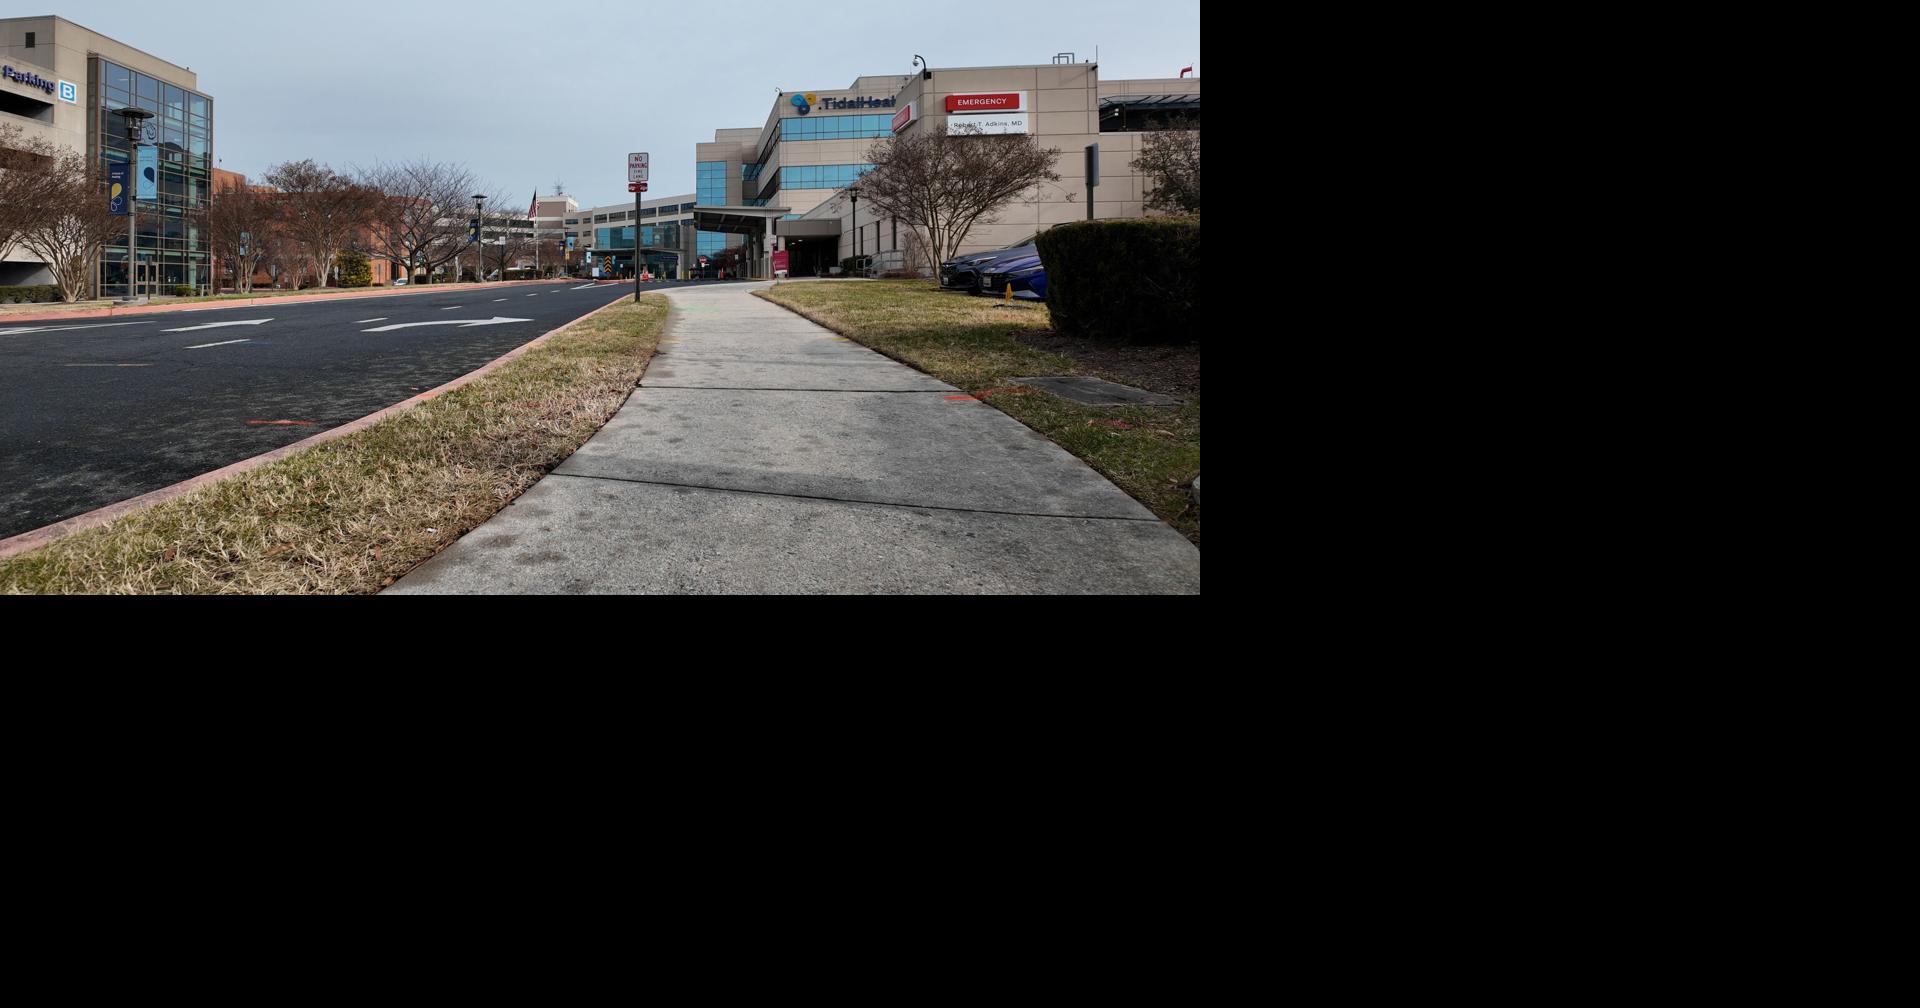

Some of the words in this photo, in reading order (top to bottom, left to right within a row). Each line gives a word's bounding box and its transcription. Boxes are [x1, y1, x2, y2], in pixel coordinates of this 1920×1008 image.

[2, 65, 55, 95] Parking
[62, 84, 73, 99] B
[822, 95, 896, 110] TidalHeal
[957, 98, 1007, 106] EMERGENCY
